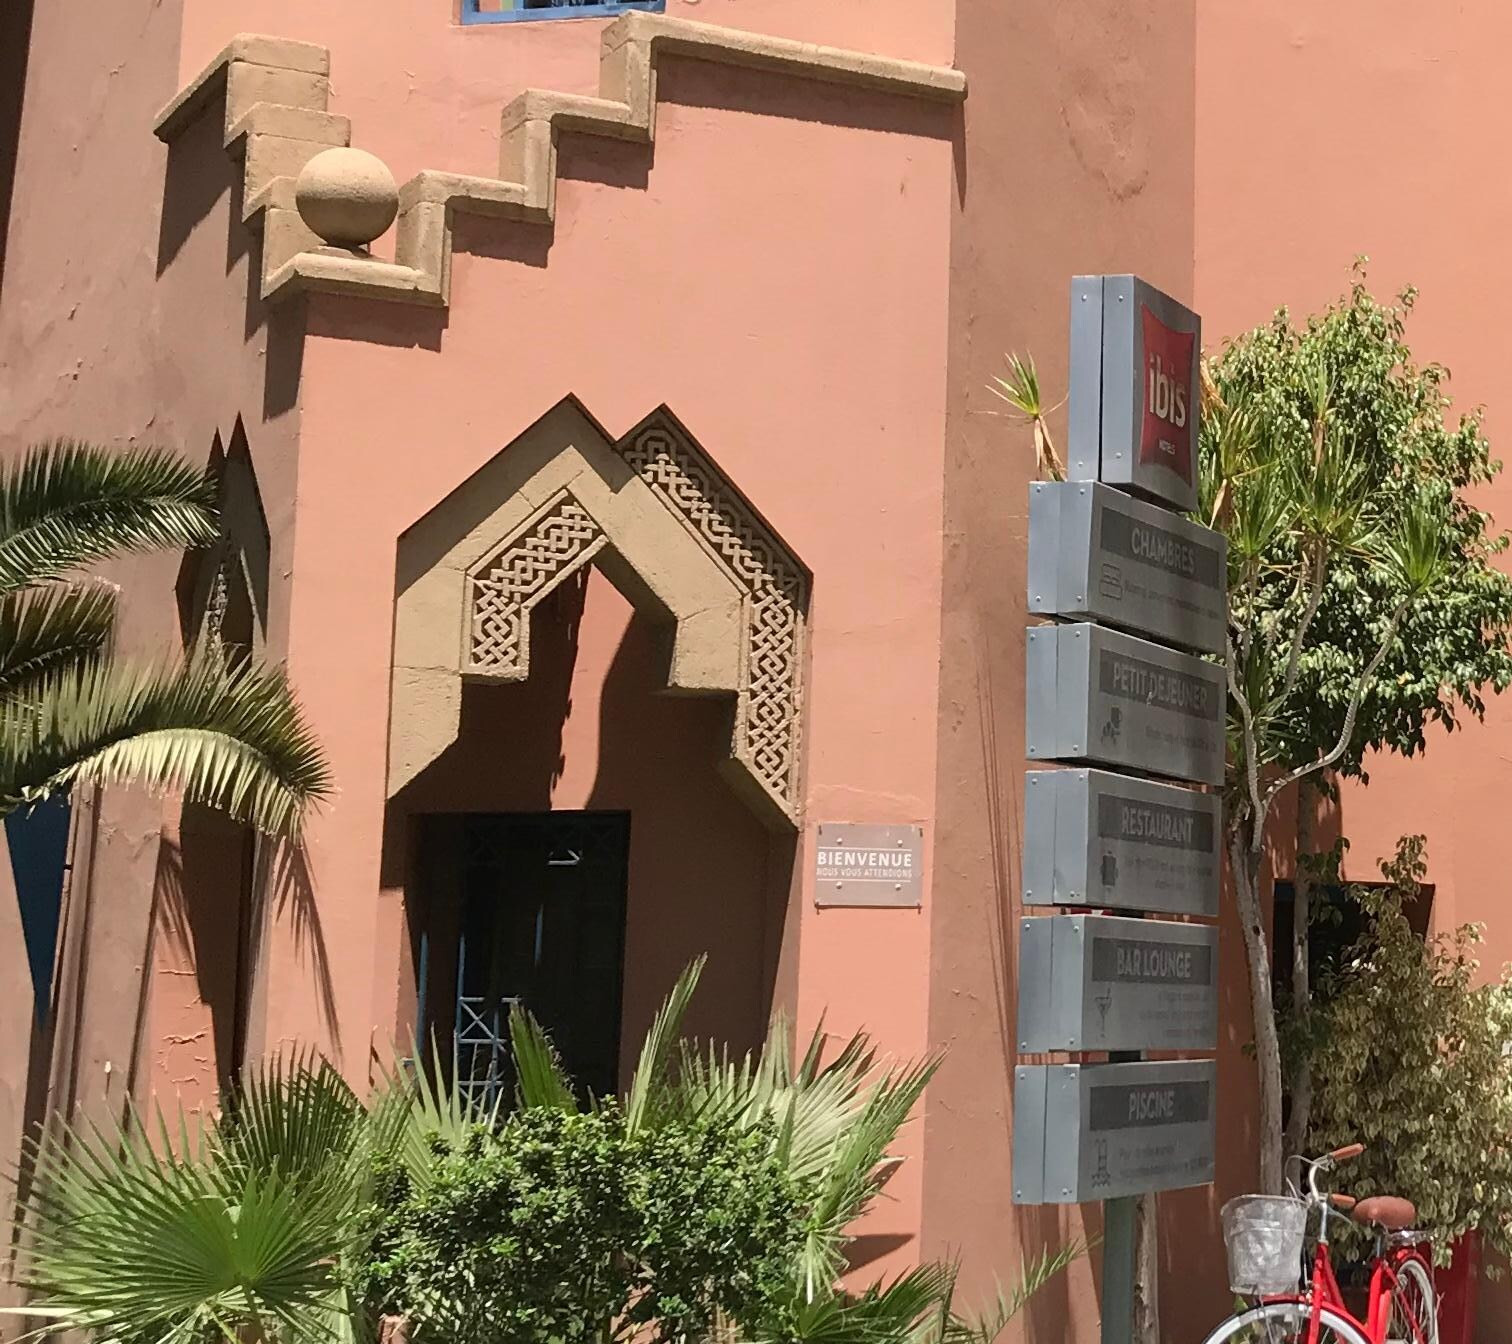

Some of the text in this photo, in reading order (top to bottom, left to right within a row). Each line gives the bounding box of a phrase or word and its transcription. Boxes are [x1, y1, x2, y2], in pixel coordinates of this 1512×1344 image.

[1149, 352, 1186, 428] ibis
[1131, 527, 1195, 575] CHAMBRES
[1113, 662, 1148, 695] PETIT
[1121, 806, 1194, 843] RESTAURANT
[816, 867, 913, 878] NOUS VOUS ATTENDIONS
[817, 851, 913, 867] BIENVENUE
[1116, 946, 1193, 978] BAR LOUNGE
[1128, 1090, 1176, 1121] PISCINE
